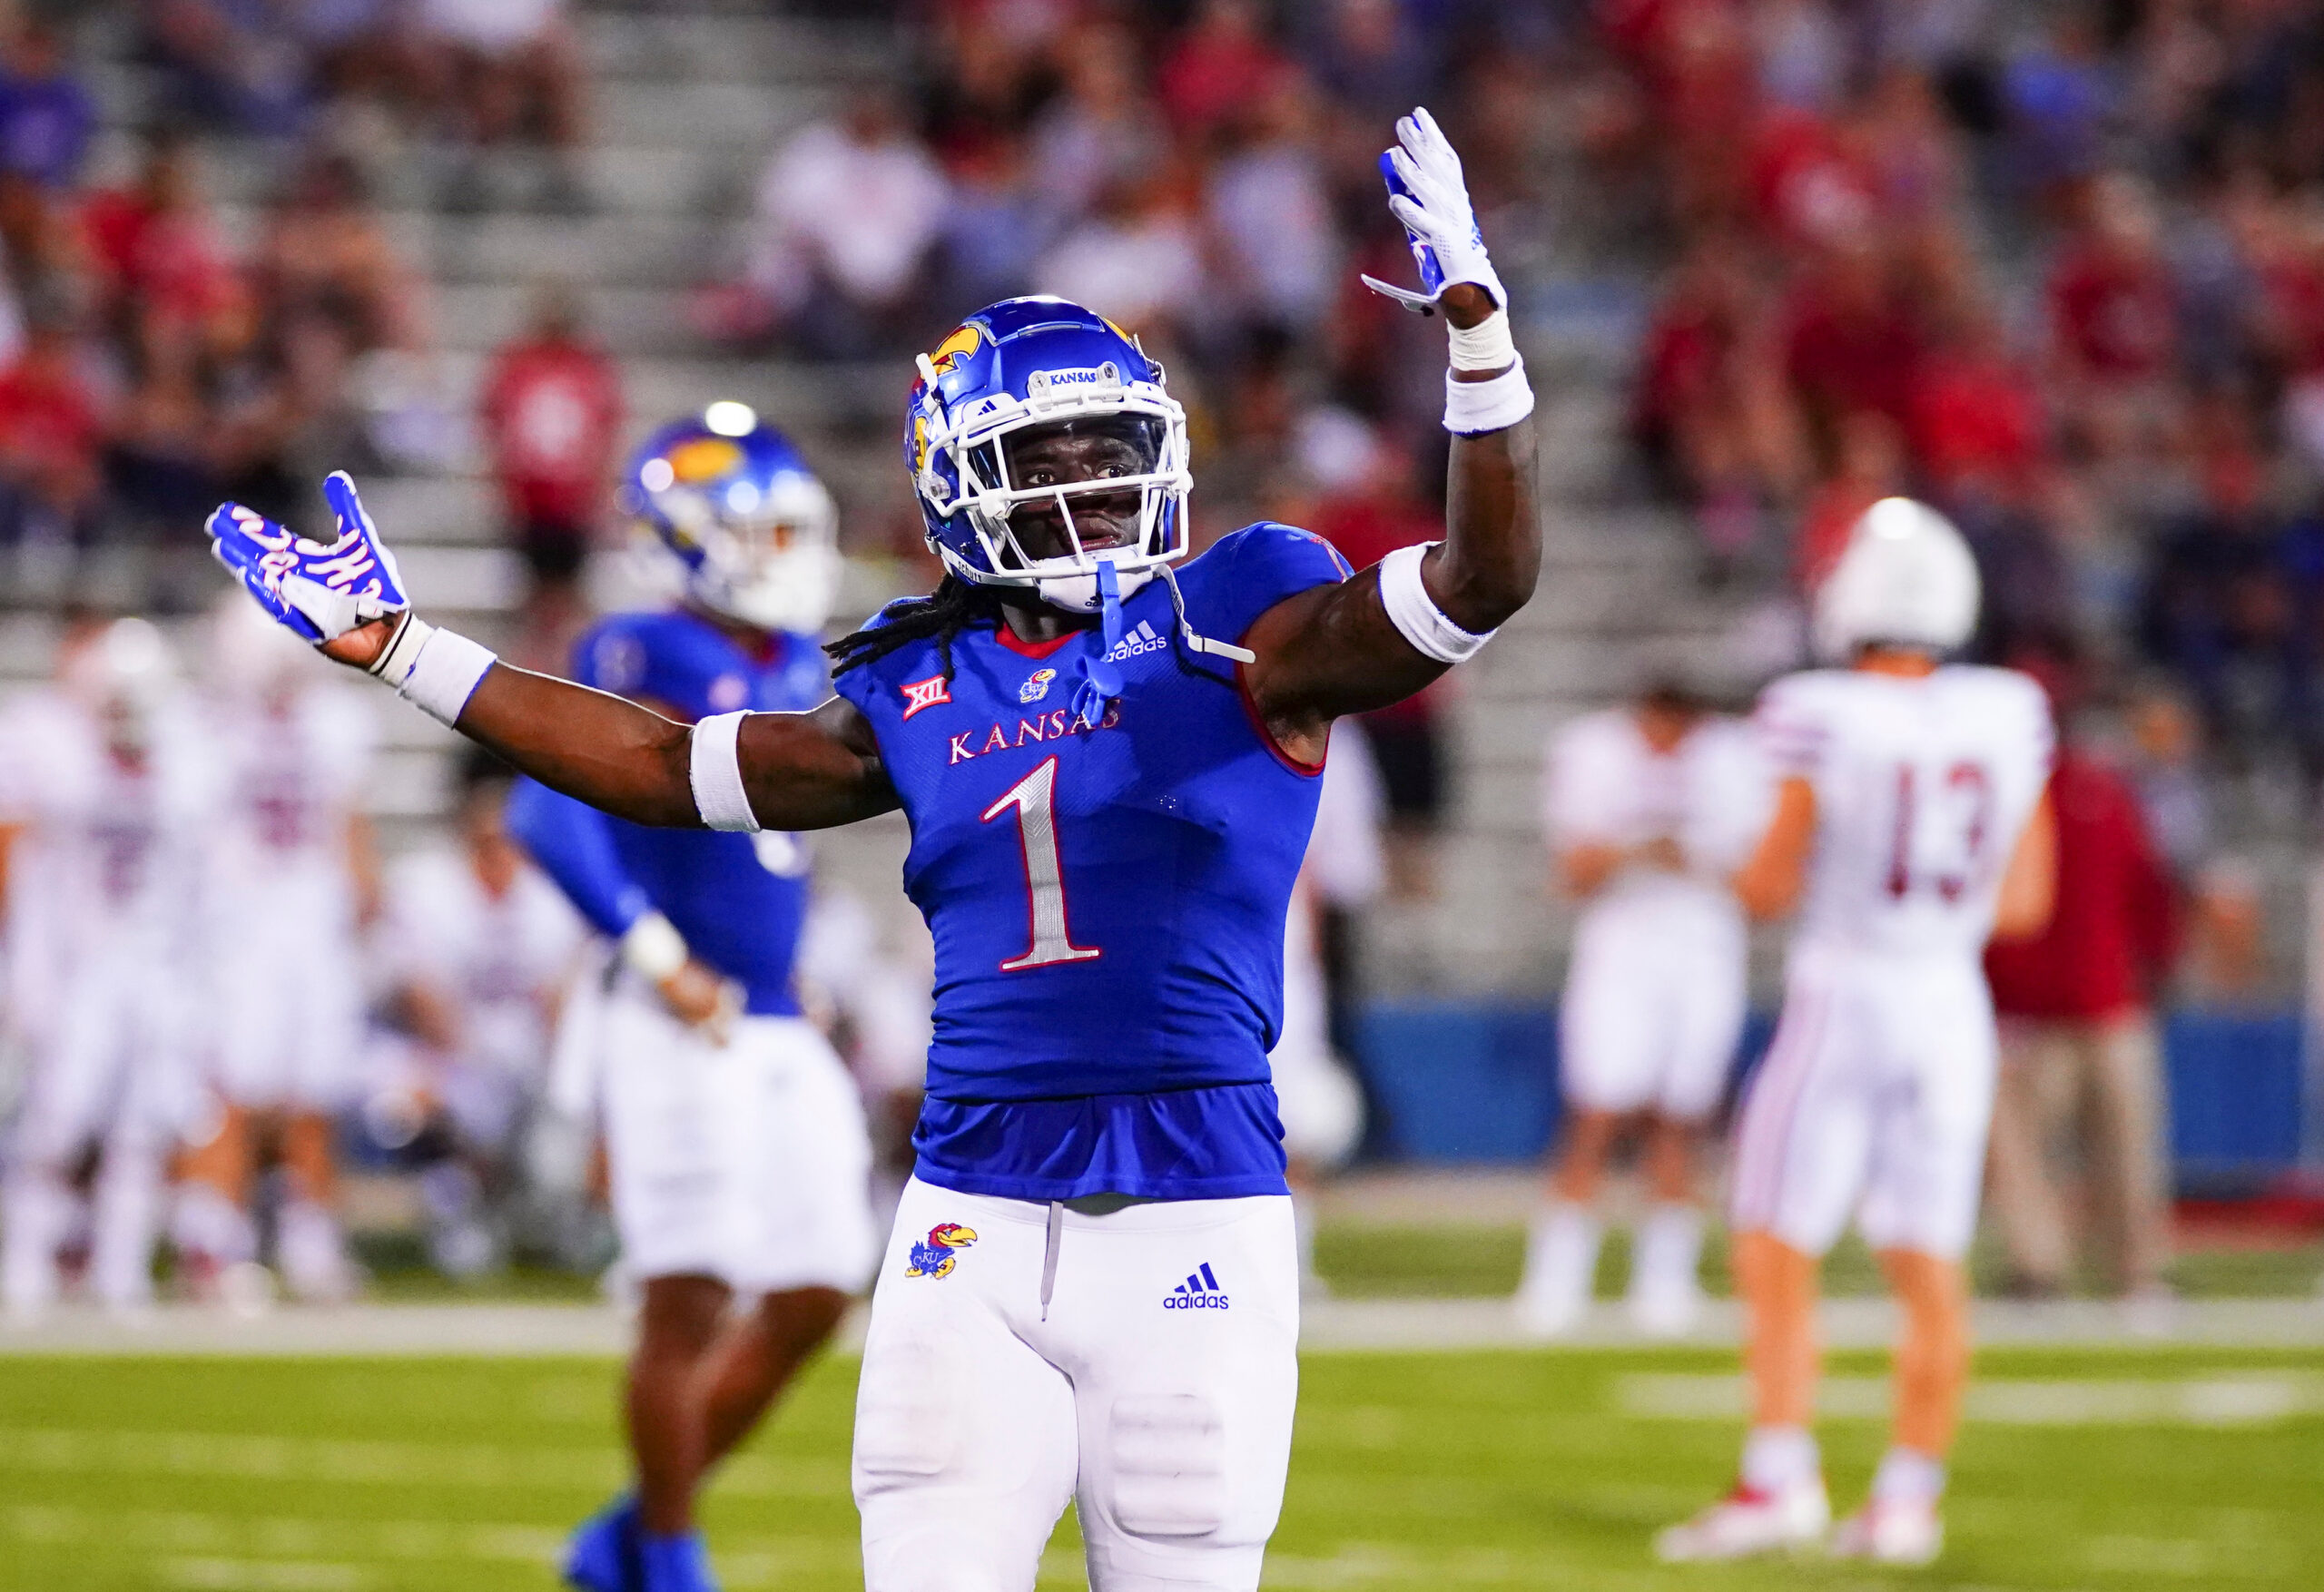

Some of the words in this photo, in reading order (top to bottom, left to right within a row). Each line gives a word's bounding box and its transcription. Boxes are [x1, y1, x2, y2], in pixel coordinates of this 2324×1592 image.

[1049, 372, 1097, 386] KANSAS
[980, 754, 1102, 972] 1
[1885, 759, 1999, 908] 13
[1163, 1292, 1229, 1310] adidas
